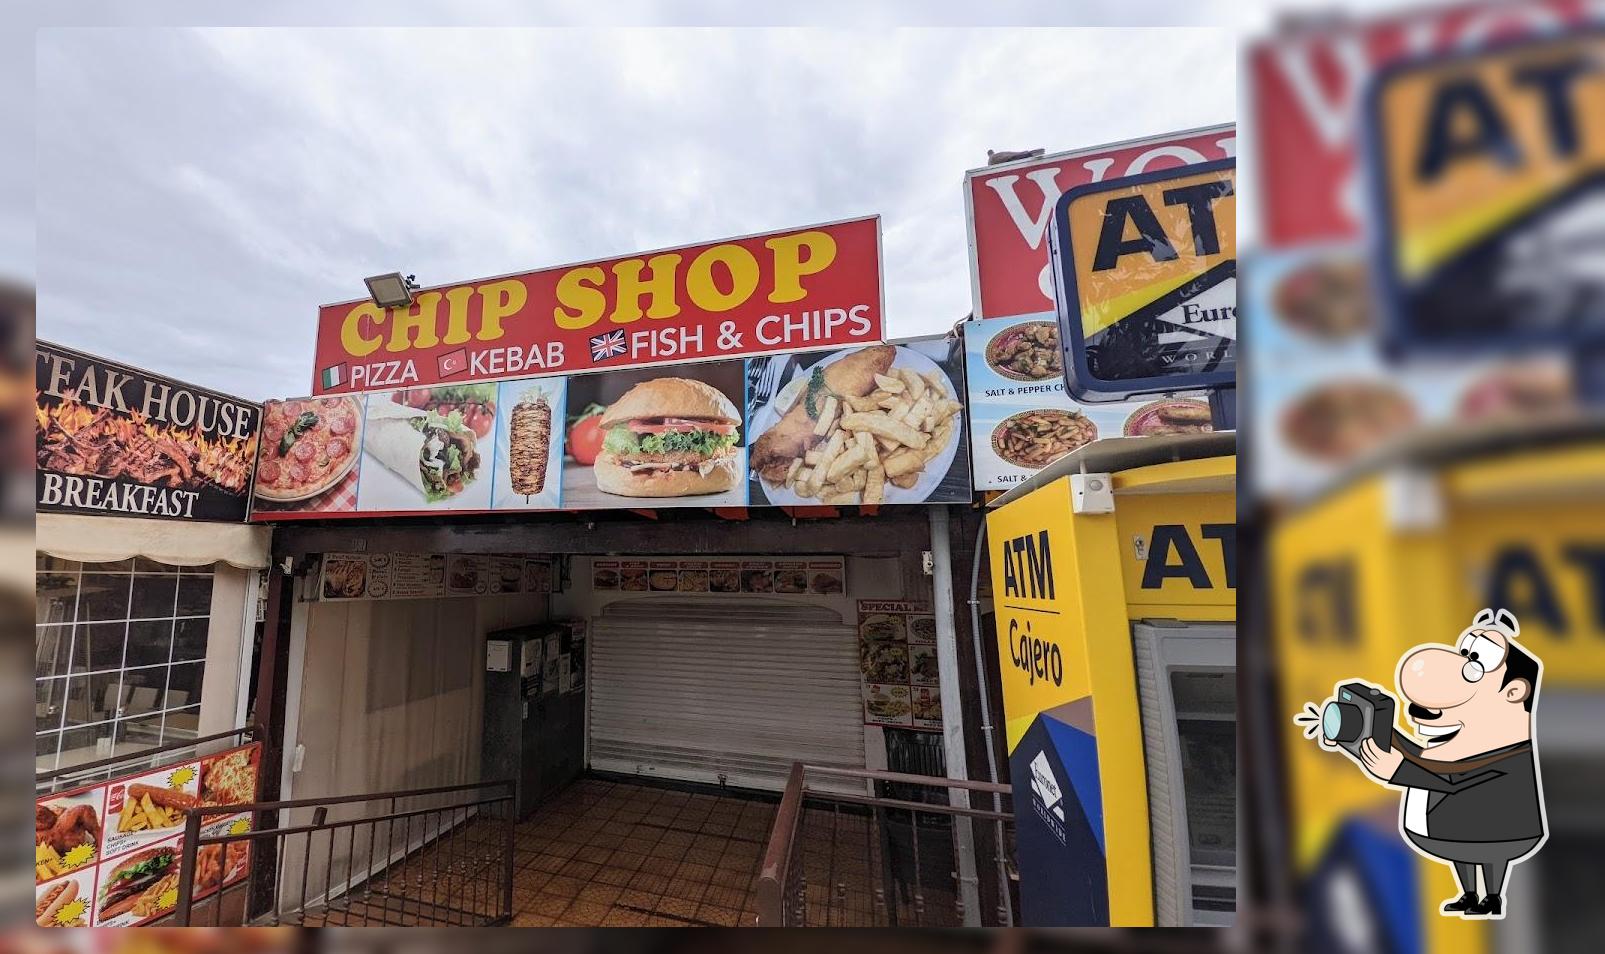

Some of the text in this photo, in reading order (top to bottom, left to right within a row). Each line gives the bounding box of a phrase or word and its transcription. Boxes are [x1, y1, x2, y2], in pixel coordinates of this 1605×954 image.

[1092, 180, 1234, 272] AT
[341, 231, 837, 357] CHIP SHOP
[632, 304, 872, 359] FISH & CHIPS
[351, 359, 420, 389] PIZZA
[470, 342, 565, 376] KEBAB
[140, 379, 251, 440] HOUSE
[985, 388, 1006, 398] SALT
[1008, 387, 1015, 395] &
[1017, 385, 1052, 394] PEPPER
[39, 473, 200, 518] BREAKFAST
[997, 475, 1018, 483] SALT
[1003, 529, 1056, 600] ATM
[860, 602, 912, 612] SPECIAL
[1009, 618, 1063, 688] Cajero
